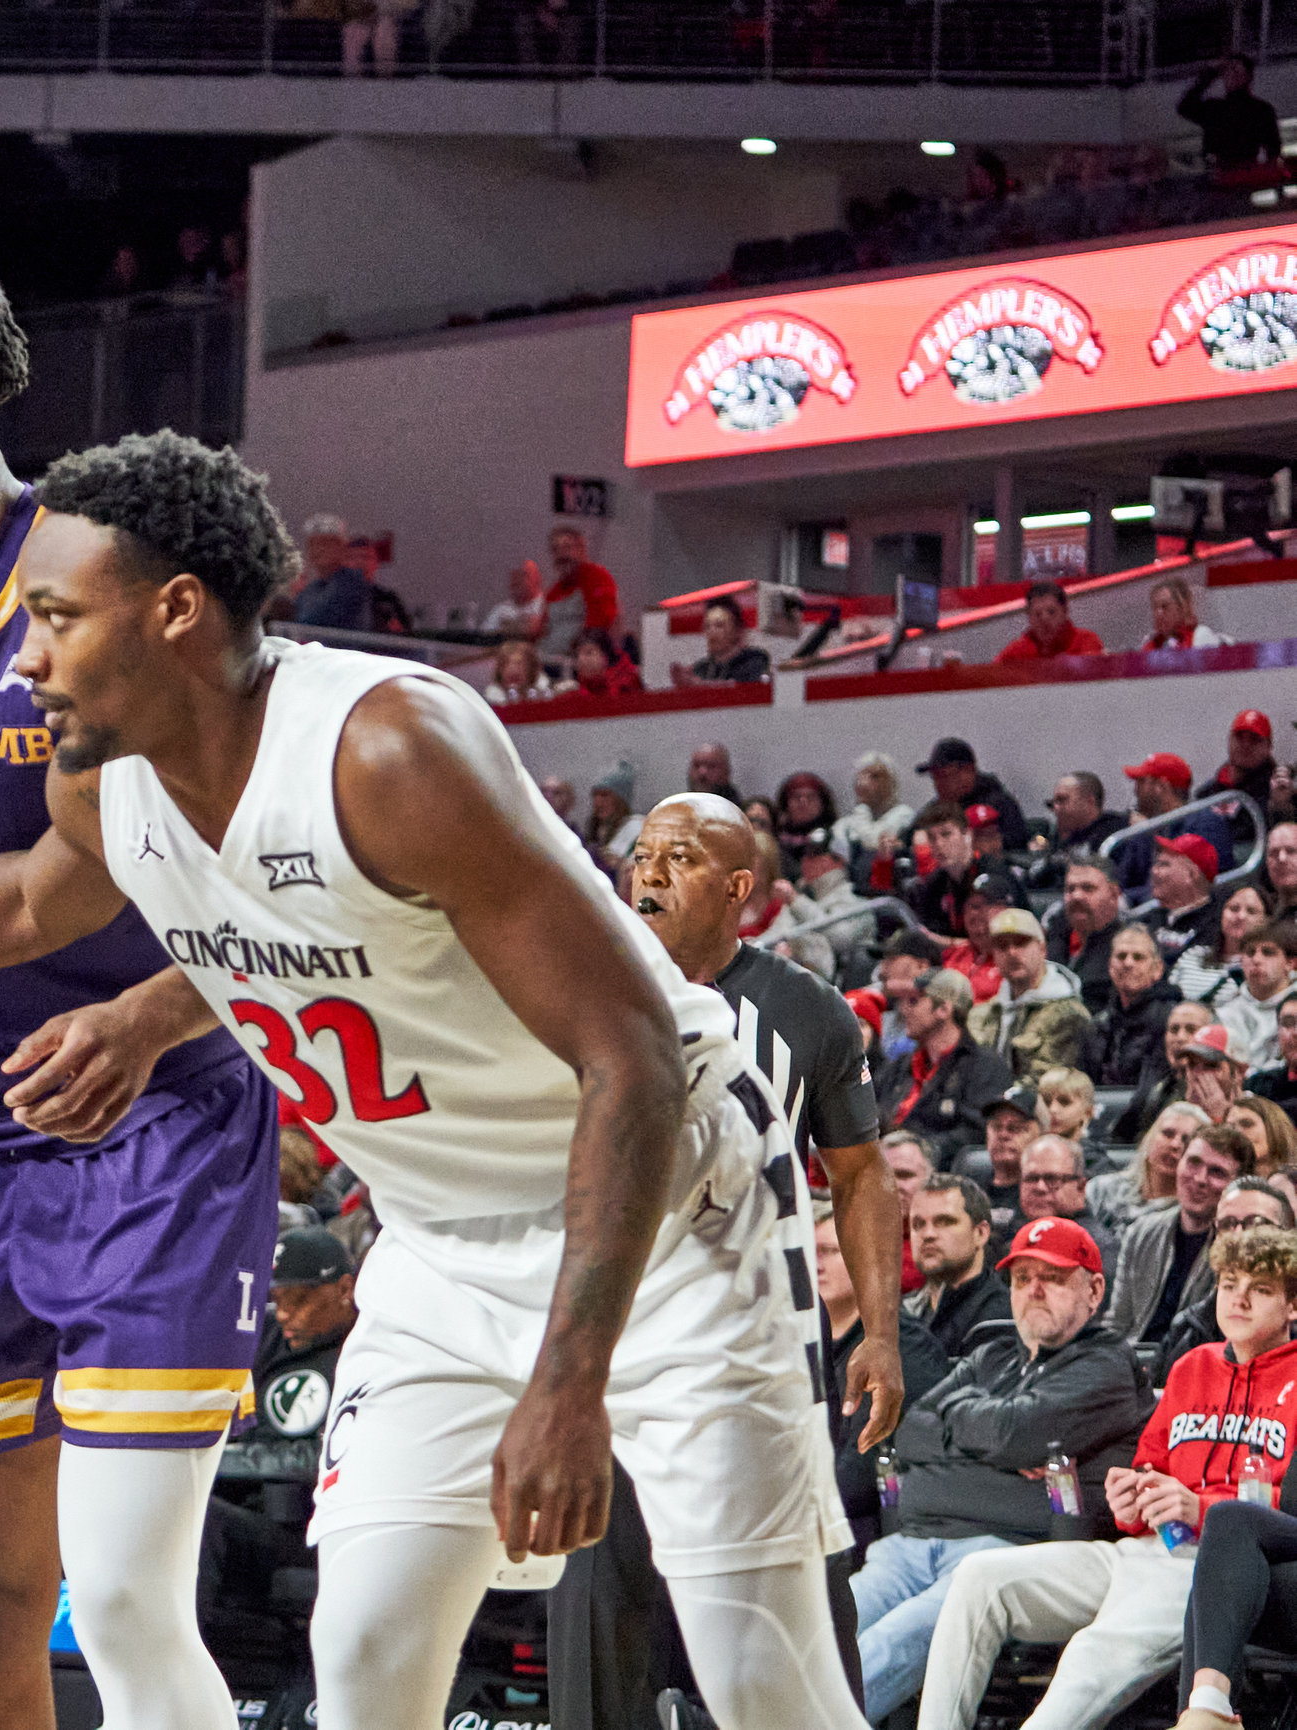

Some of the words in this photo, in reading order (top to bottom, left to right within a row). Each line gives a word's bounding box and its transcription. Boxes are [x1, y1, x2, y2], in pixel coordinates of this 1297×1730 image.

[165, 922, 373, 980] CINCINNATI
[227, 996, 432, 1126] 32
[236, 1270, 257, 1332] L
[1167, 1412, 1287, 1460] BEARCATS
